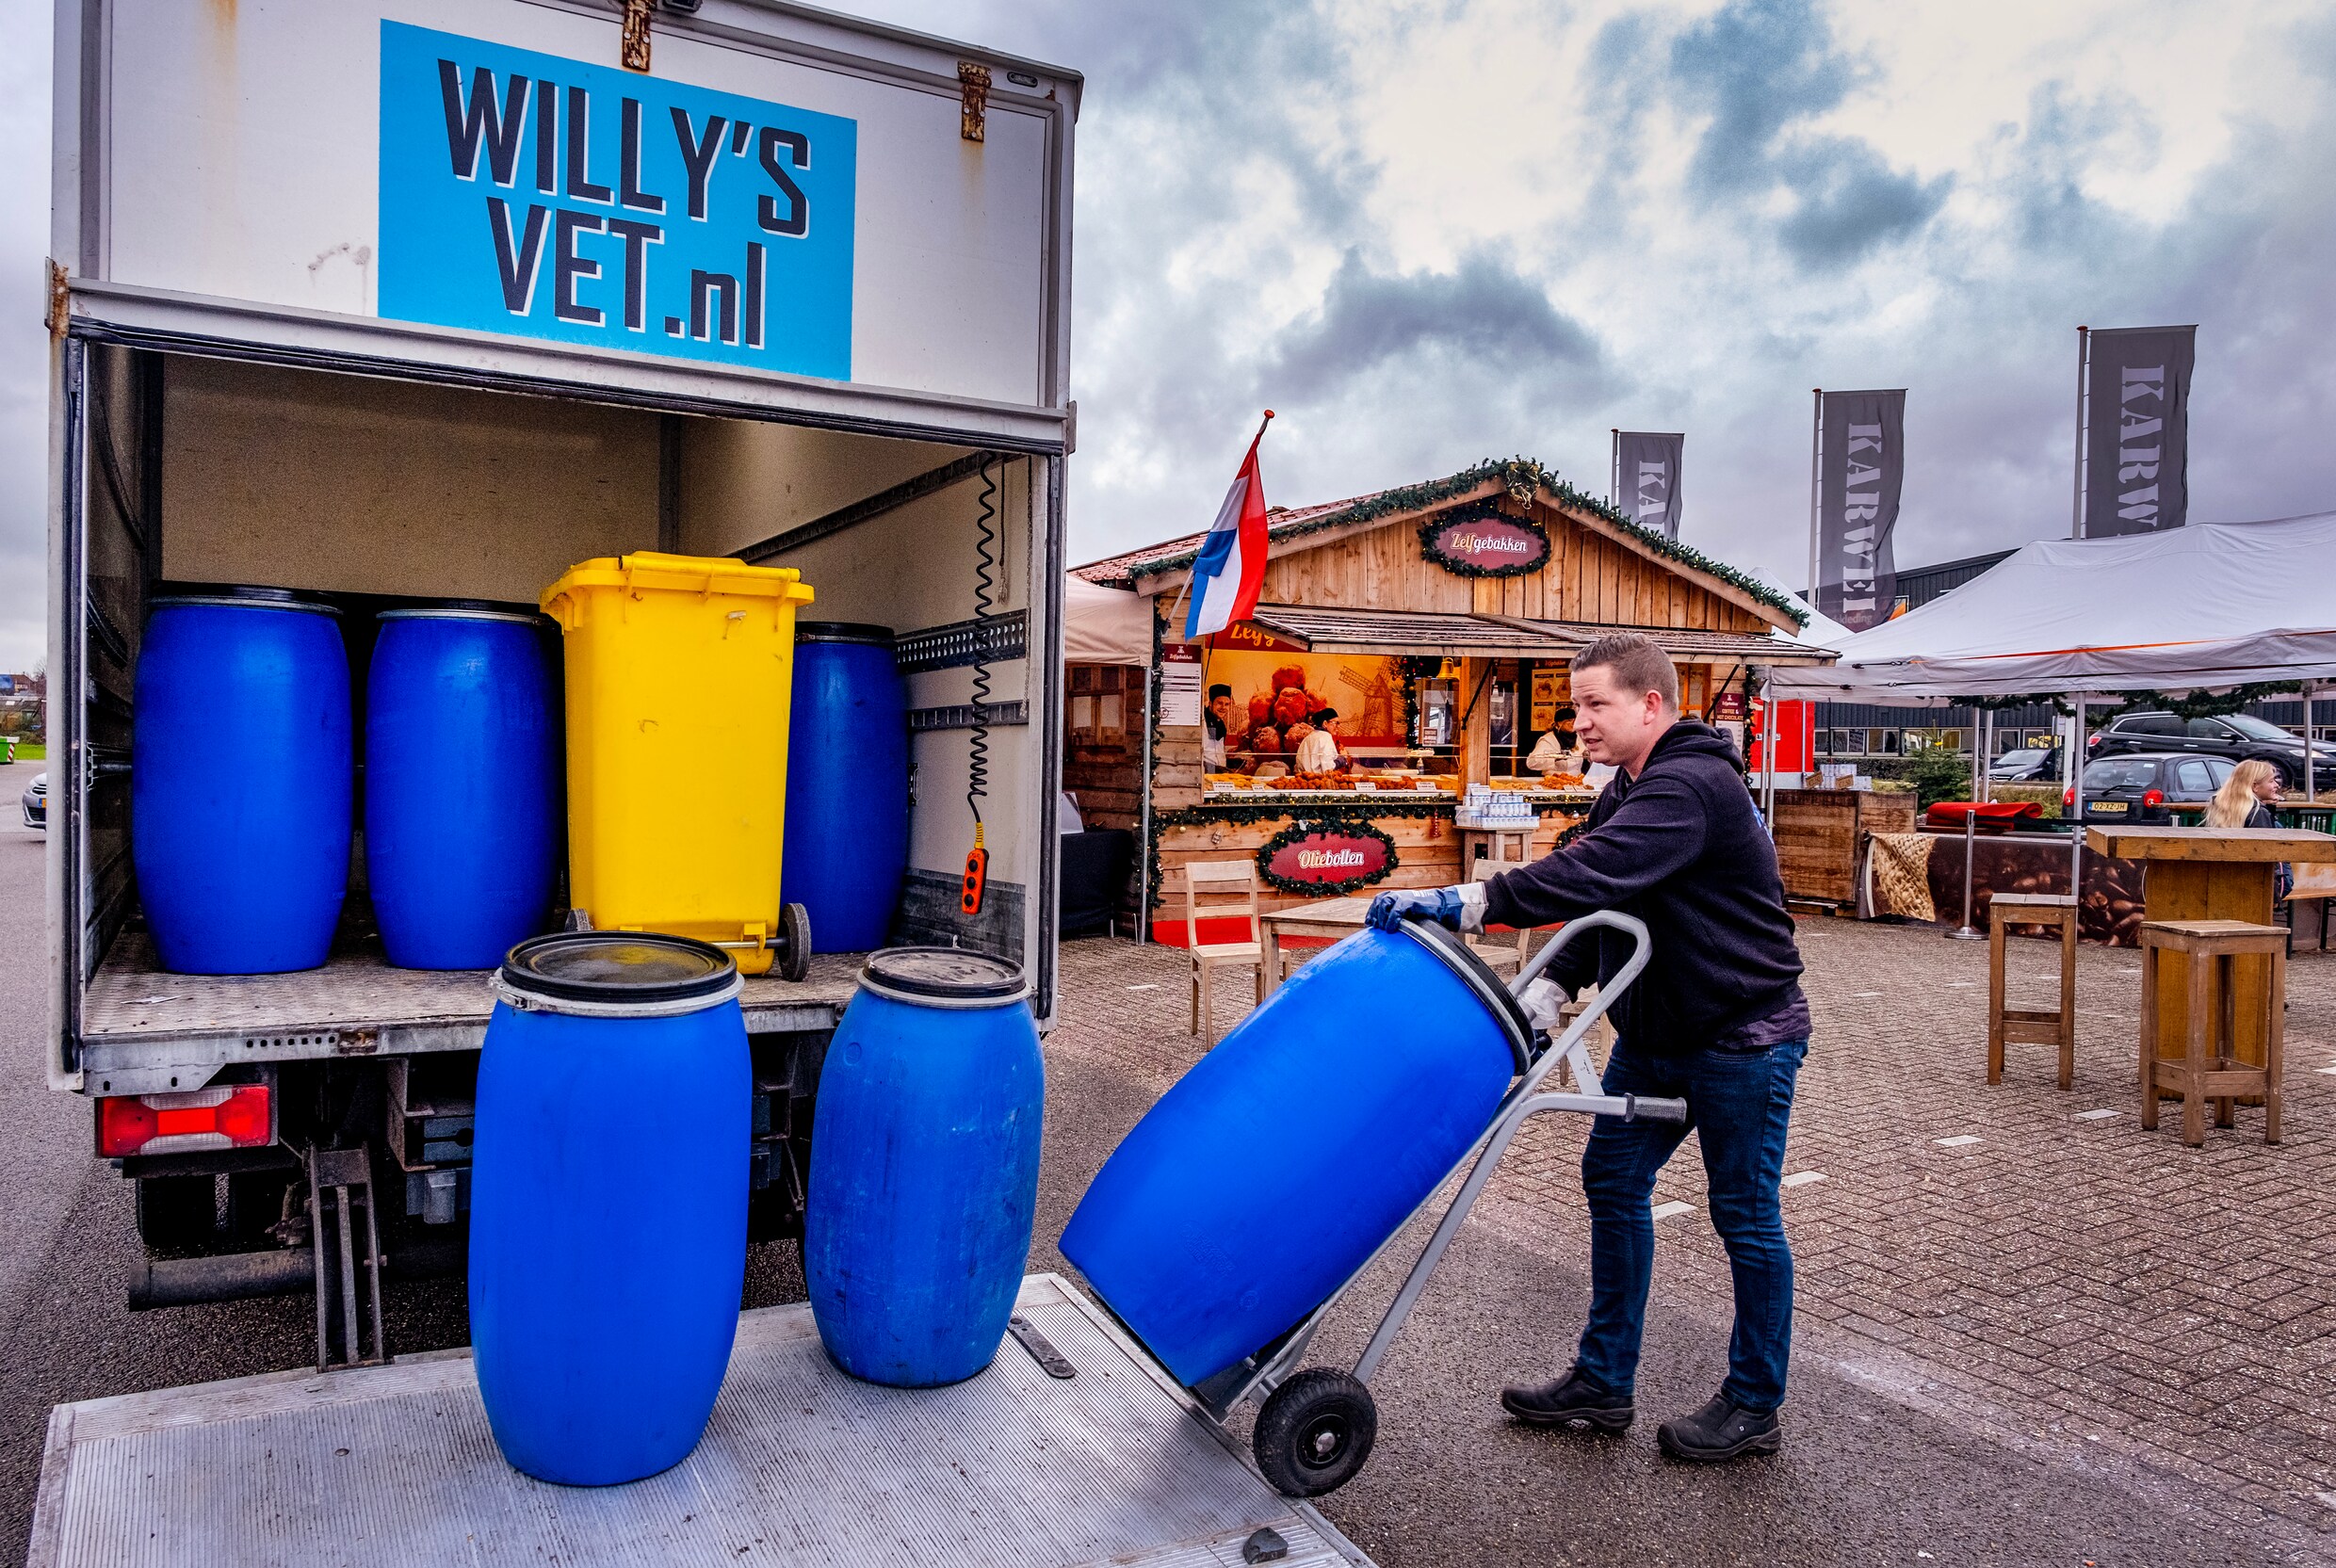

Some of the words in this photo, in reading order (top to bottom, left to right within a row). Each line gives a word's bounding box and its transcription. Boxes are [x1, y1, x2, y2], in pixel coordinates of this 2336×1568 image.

[437, 57, 811, 239] WILLY'S
[486, 196, 767, 350] VET.nl
[1842, 423, 1882, 614] KARWEI
[2117, 364, 2165, 527] KARW
[1451, 532, 1527, 554] Zelfgebakken
[1298, 849, 1364, 868] Oliebollen
